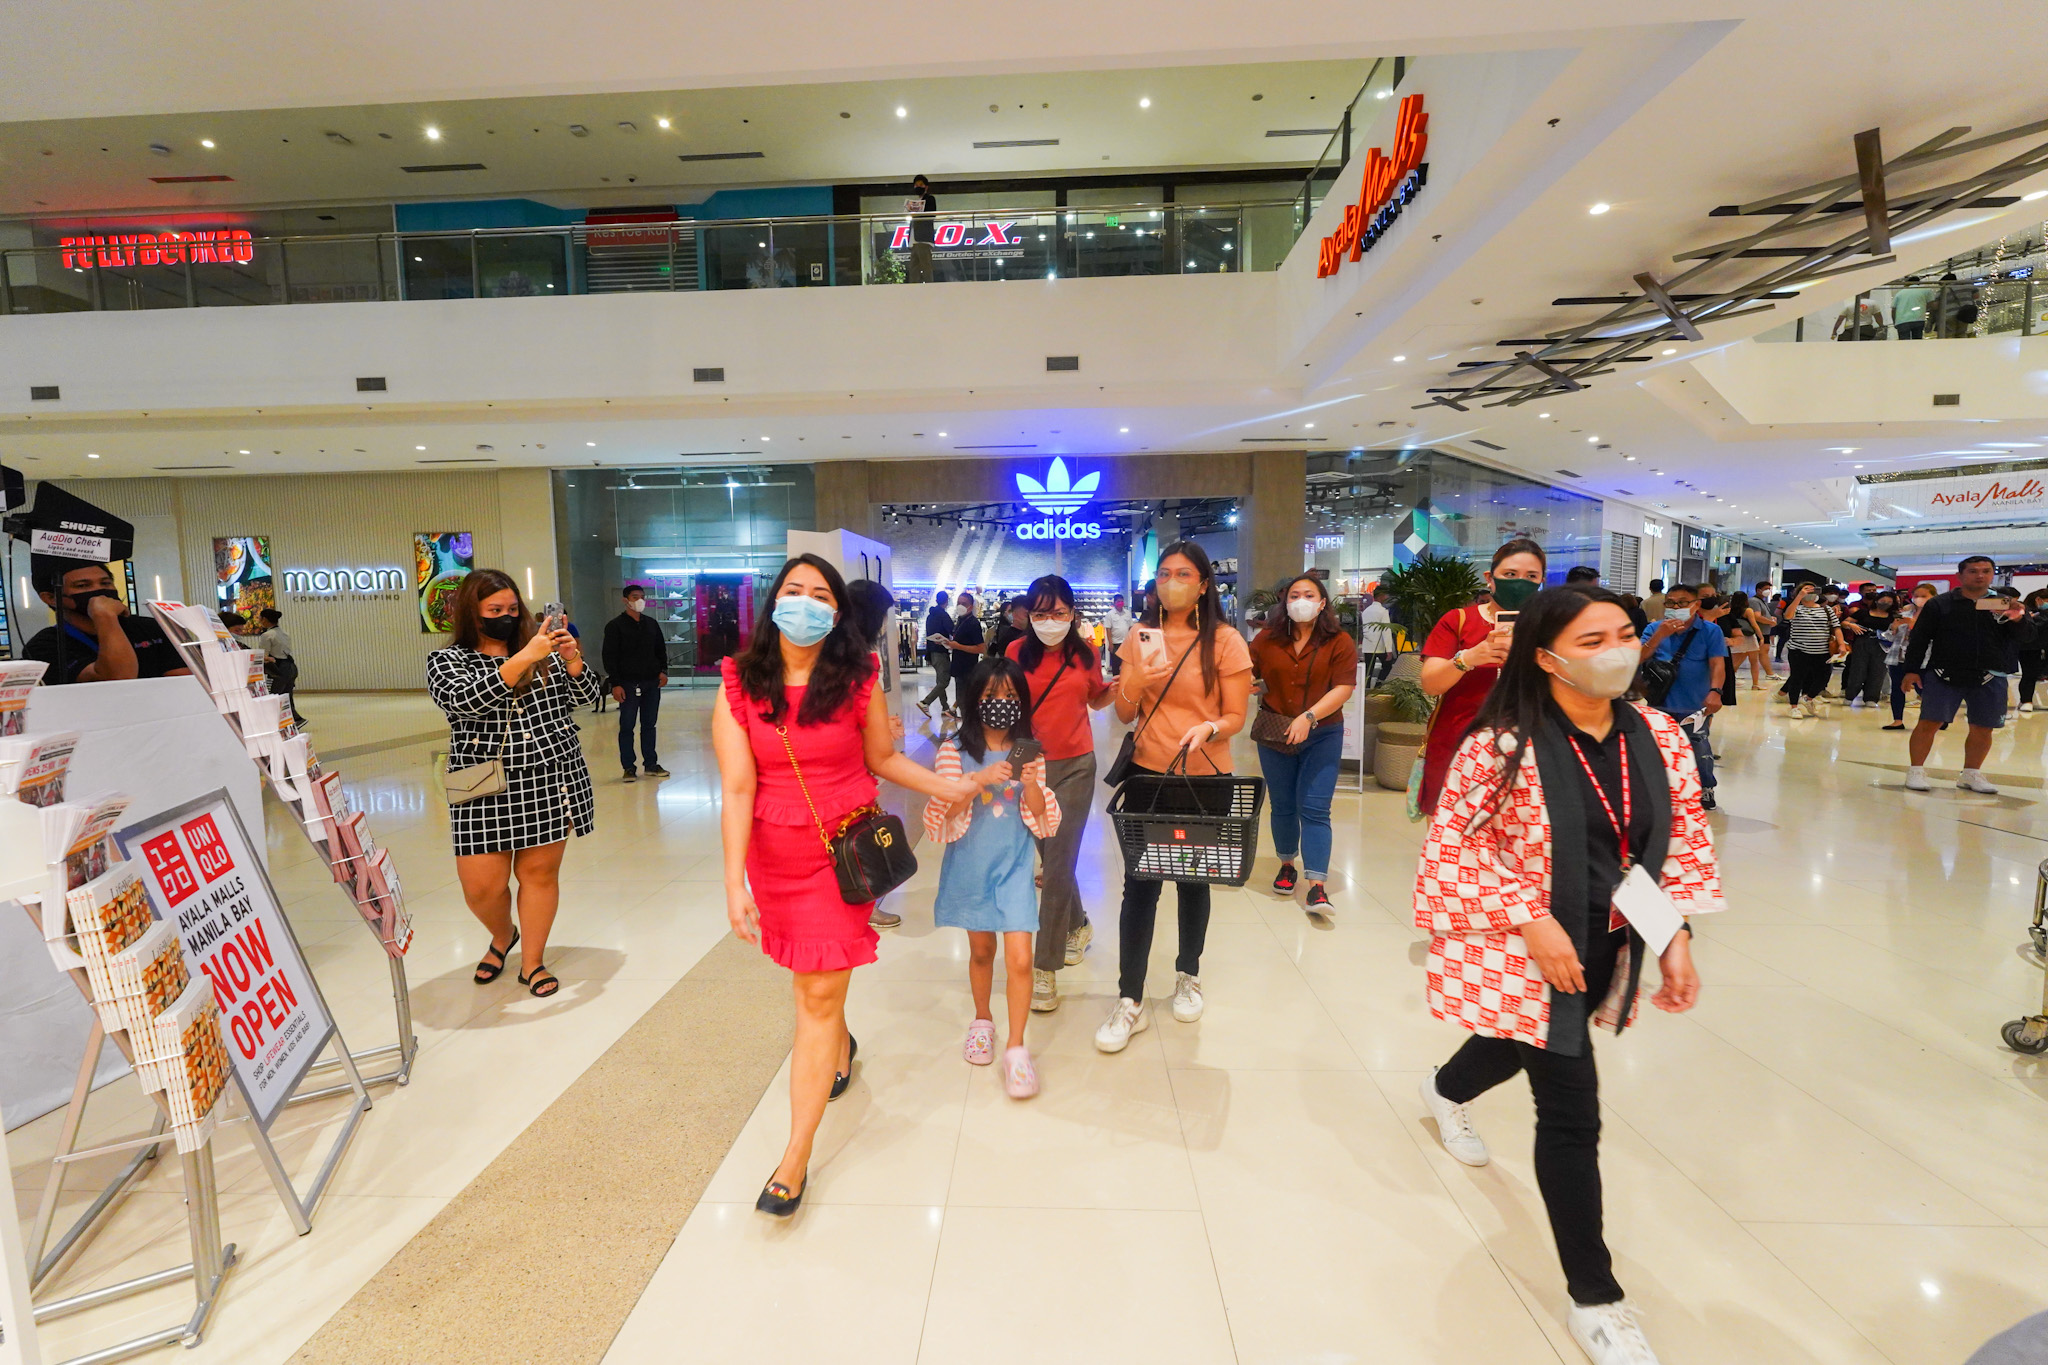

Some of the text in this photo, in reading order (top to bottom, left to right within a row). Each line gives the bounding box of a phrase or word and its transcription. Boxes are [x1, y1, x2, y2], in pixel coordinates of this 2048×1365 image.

[1317, 94, 1429, 278] Ayala Malls
[60, 230, 253, 268] FULLYBOOKED
[1931, 478, 2045, 509] Ayala Malls
[40, 532, 103, 547] AudDio Check
[60, 520, 105, 534] SHURE
[1015, 518, 1101, 540] adidas
[1316, 536, 1344, 549] OPEN
[282, 568, 406, 592] manam
[293, 593, 401, 603] COMFORT FILIPINO
[187, 822, 217, 850] UNI
[199, 845, 228, 876] QLO
[178, 876, 245, 933] AYALA MALLS
[187, 895, 254, 957] MANILA BAY
[200, 917, 274, 1015] NOW
[230, 968, 298, 1060] OPEN
[252, 1010, 307, 1080] SHOP LIFEWEAR ESSENTIALS
[259, 1078, 268, 1091] FOR
[295, 1031, 303, 1043] AND
